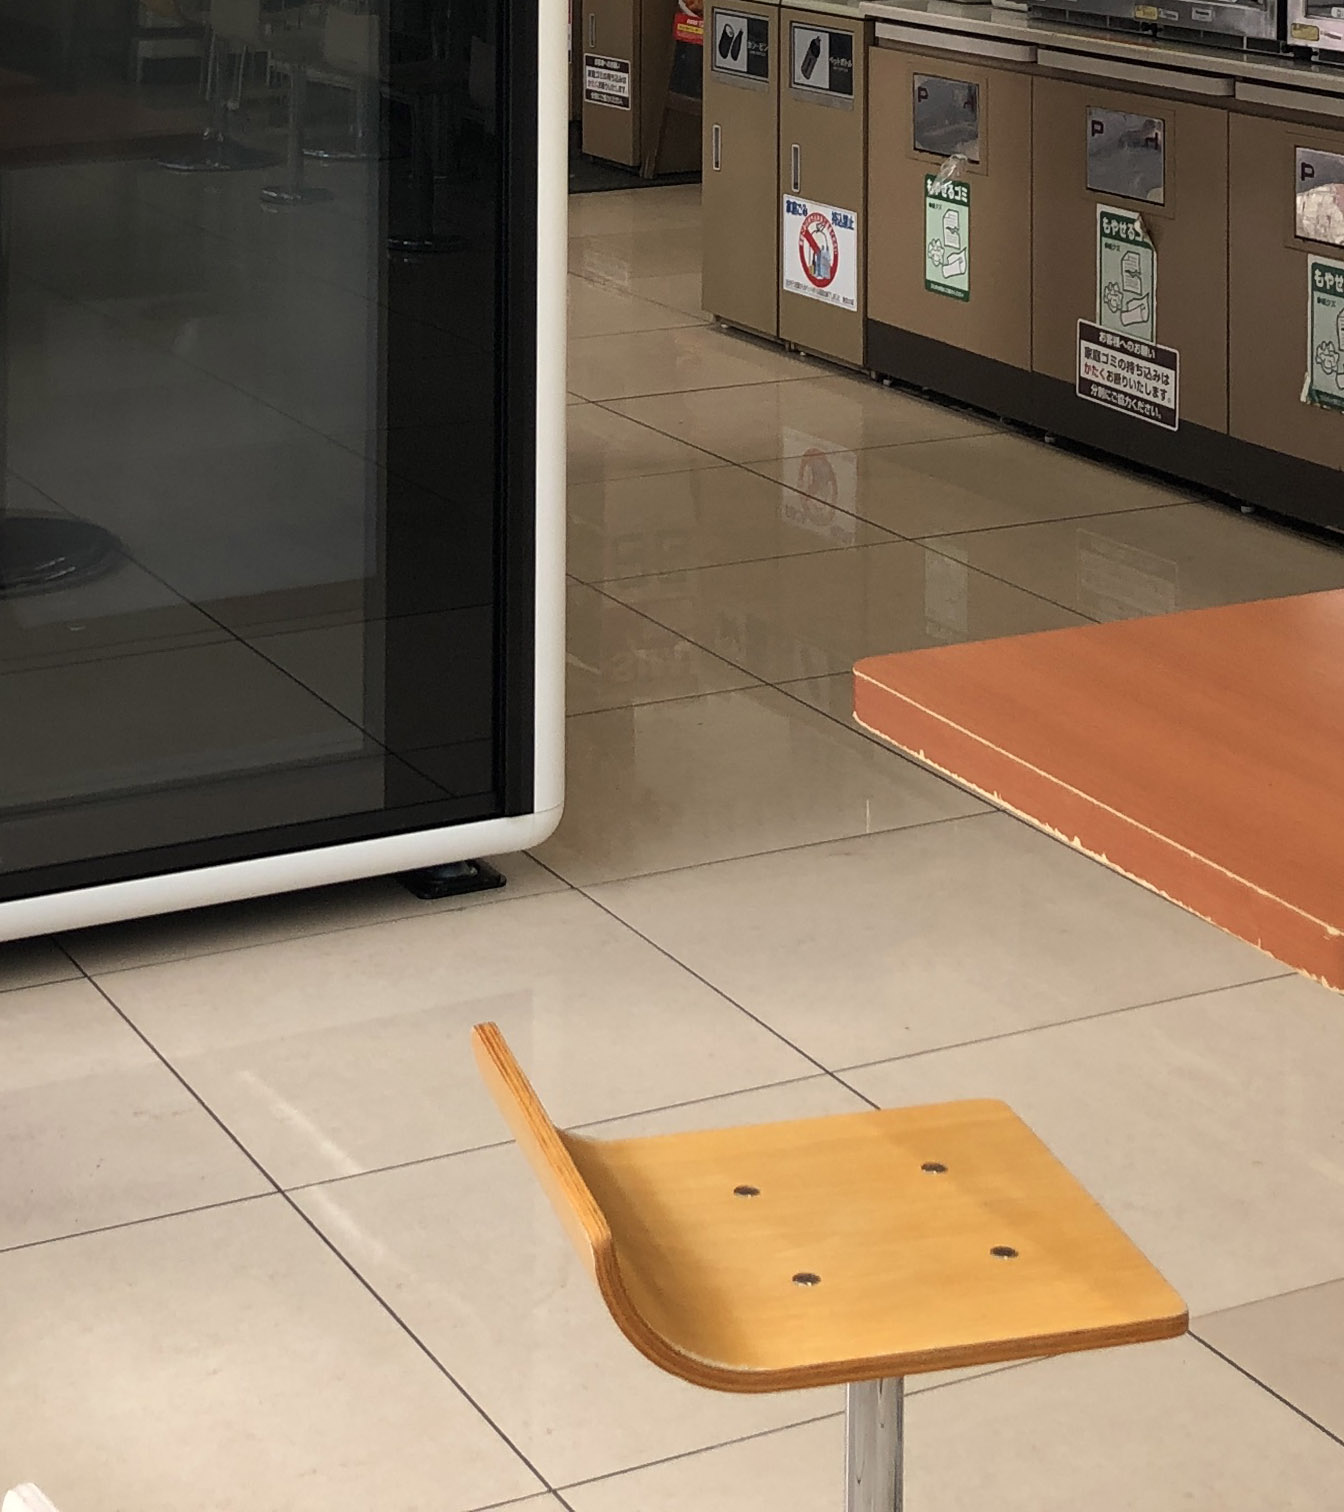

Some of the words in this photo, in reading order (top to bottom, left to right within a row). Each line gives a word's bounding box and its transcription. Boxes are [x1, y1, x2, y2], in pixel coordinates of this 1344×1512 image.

[1084, 346, 1170, 386] 家庭ゴミの持ち込みは
